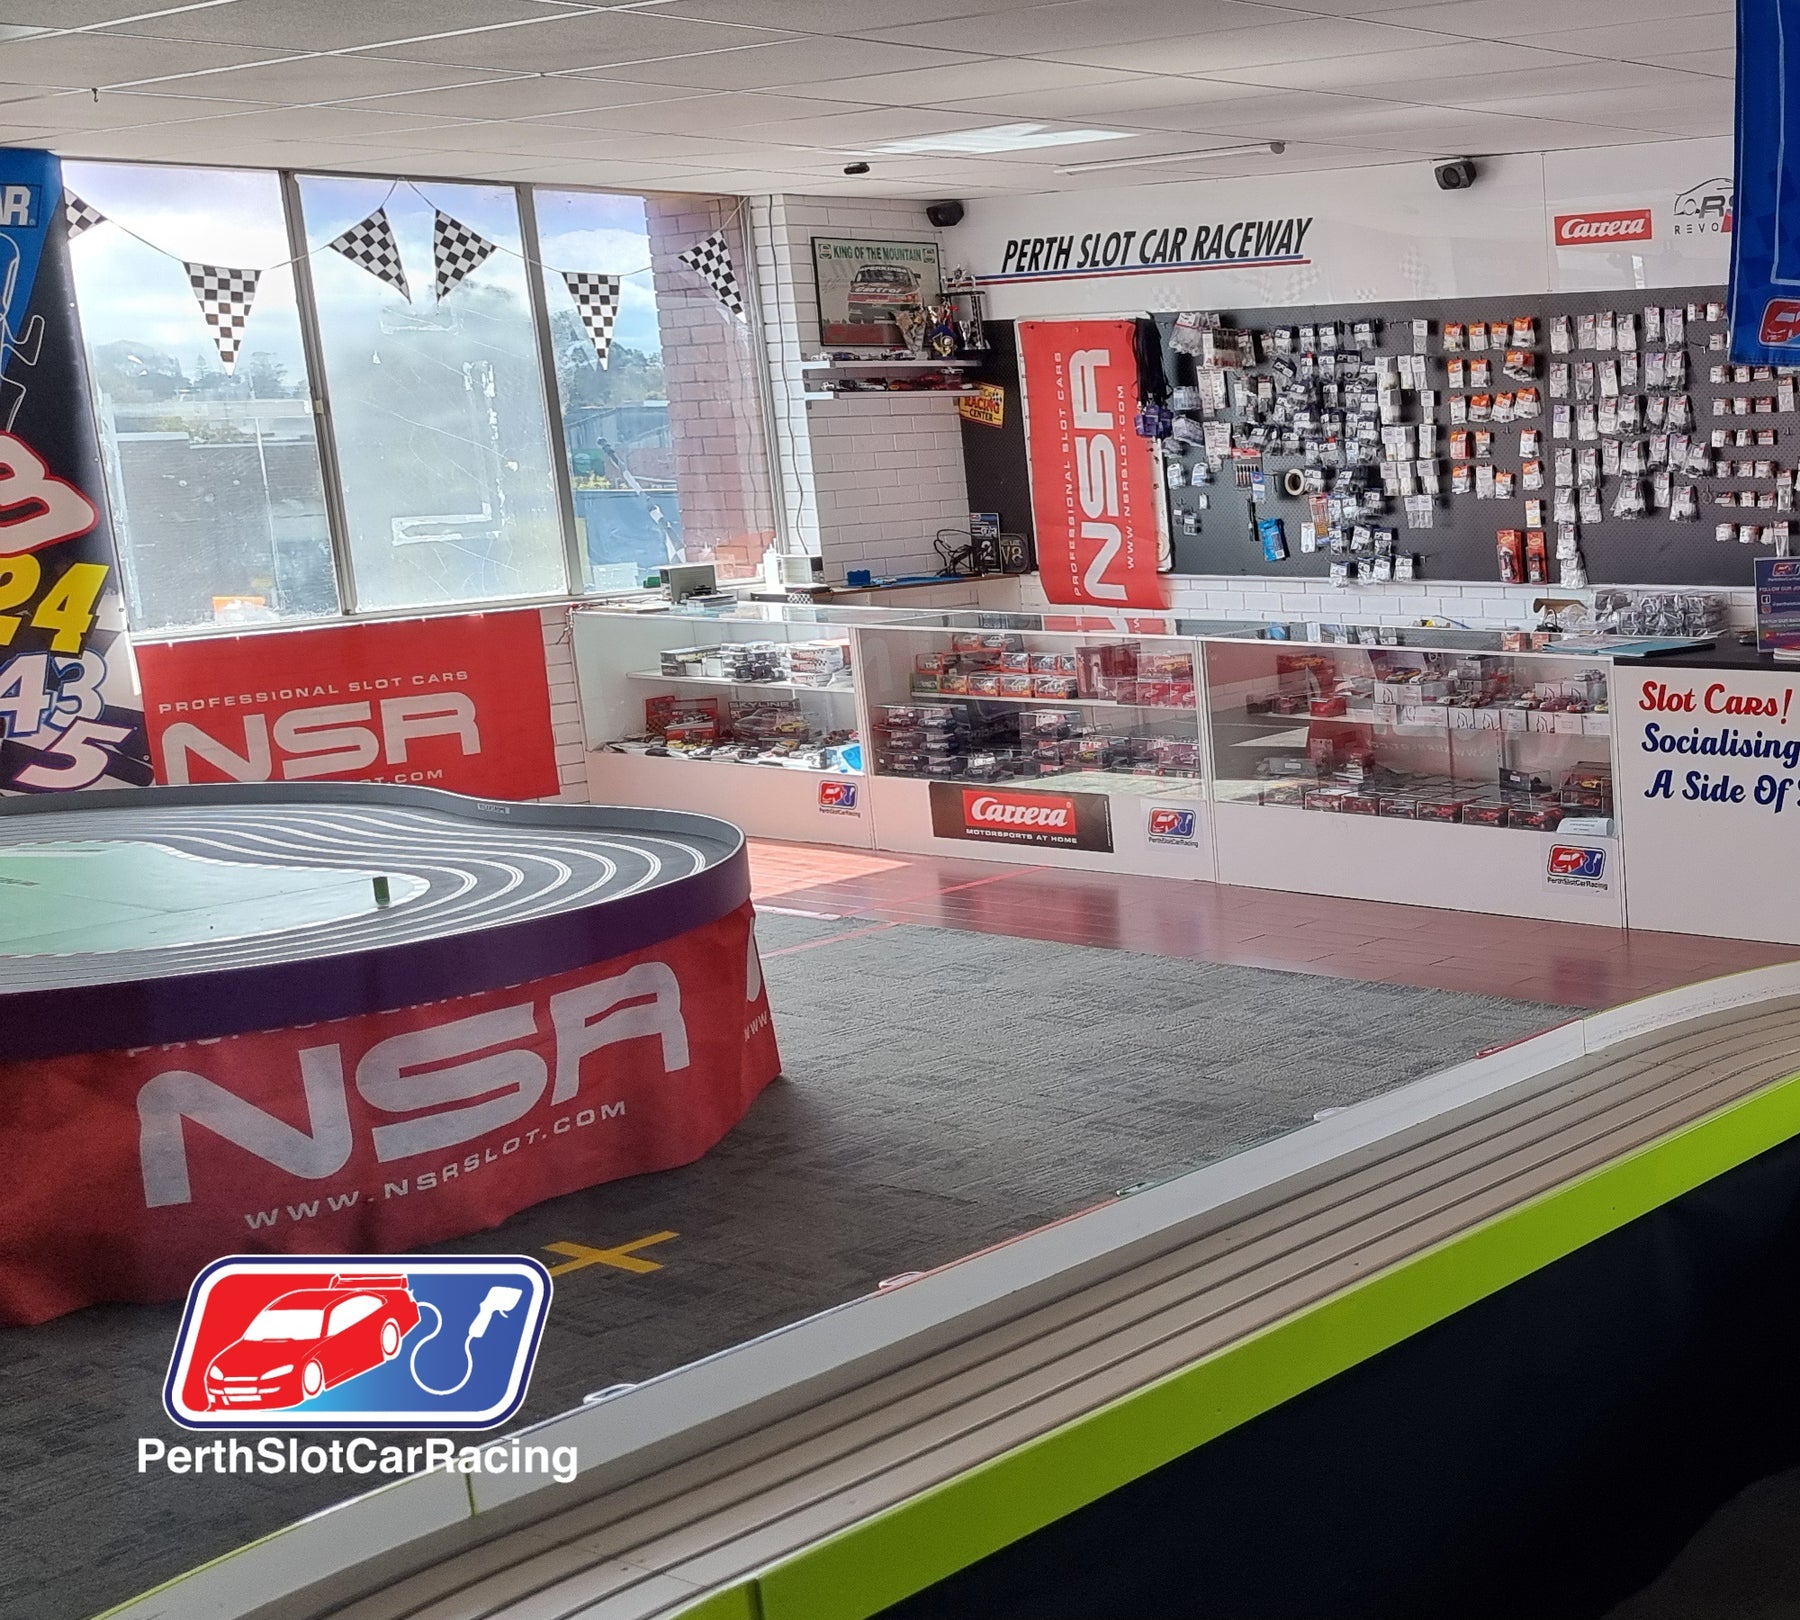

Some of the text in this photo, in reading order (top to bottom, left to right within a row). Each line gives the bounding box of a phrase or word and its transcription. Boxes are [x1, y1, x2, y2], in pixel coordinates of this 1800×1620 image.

[1001, 217, 1314, 274] PERTH SLOT CAR RACEWAY
[1561, 217, 1646, 239] Carrera
[833, 246, 853, 258] KING
[854, 247, 865, 259] OF
[866, 247, 882, 259] THE
[883, 247, 922, 261] MOUNTAIN
[969, 408, 993, 422] CENTER
[1069, 349, 1129, 600] NSR
[1062, 462, 1082, 597] PROFESSIONAL
[0, 651, 106, 734] 43
[159, 670, 469, 714] PROFESSIONAL SLOT CARS
[1638, 681, 1697, 714] Slot
[13, 719, 136, 791] 5
[161, 691, 482, 785] NSR
[1641, 722, 1800, 769] Socialising
[970, 796, 1069, 828] Carrera
[1644, 769, 1675, 800] A
[1682, 770, 1746, 804] Side
[1753, 774, 1791, 815] Of
[966, 828, 1034, 840] MOTORSPORTS
[1051, 836, 1078, 844] HOME
[136, 961, 690, 1208] NSR
[244, 1099, 628, 1229] WWW.NSRSLOT.COM
